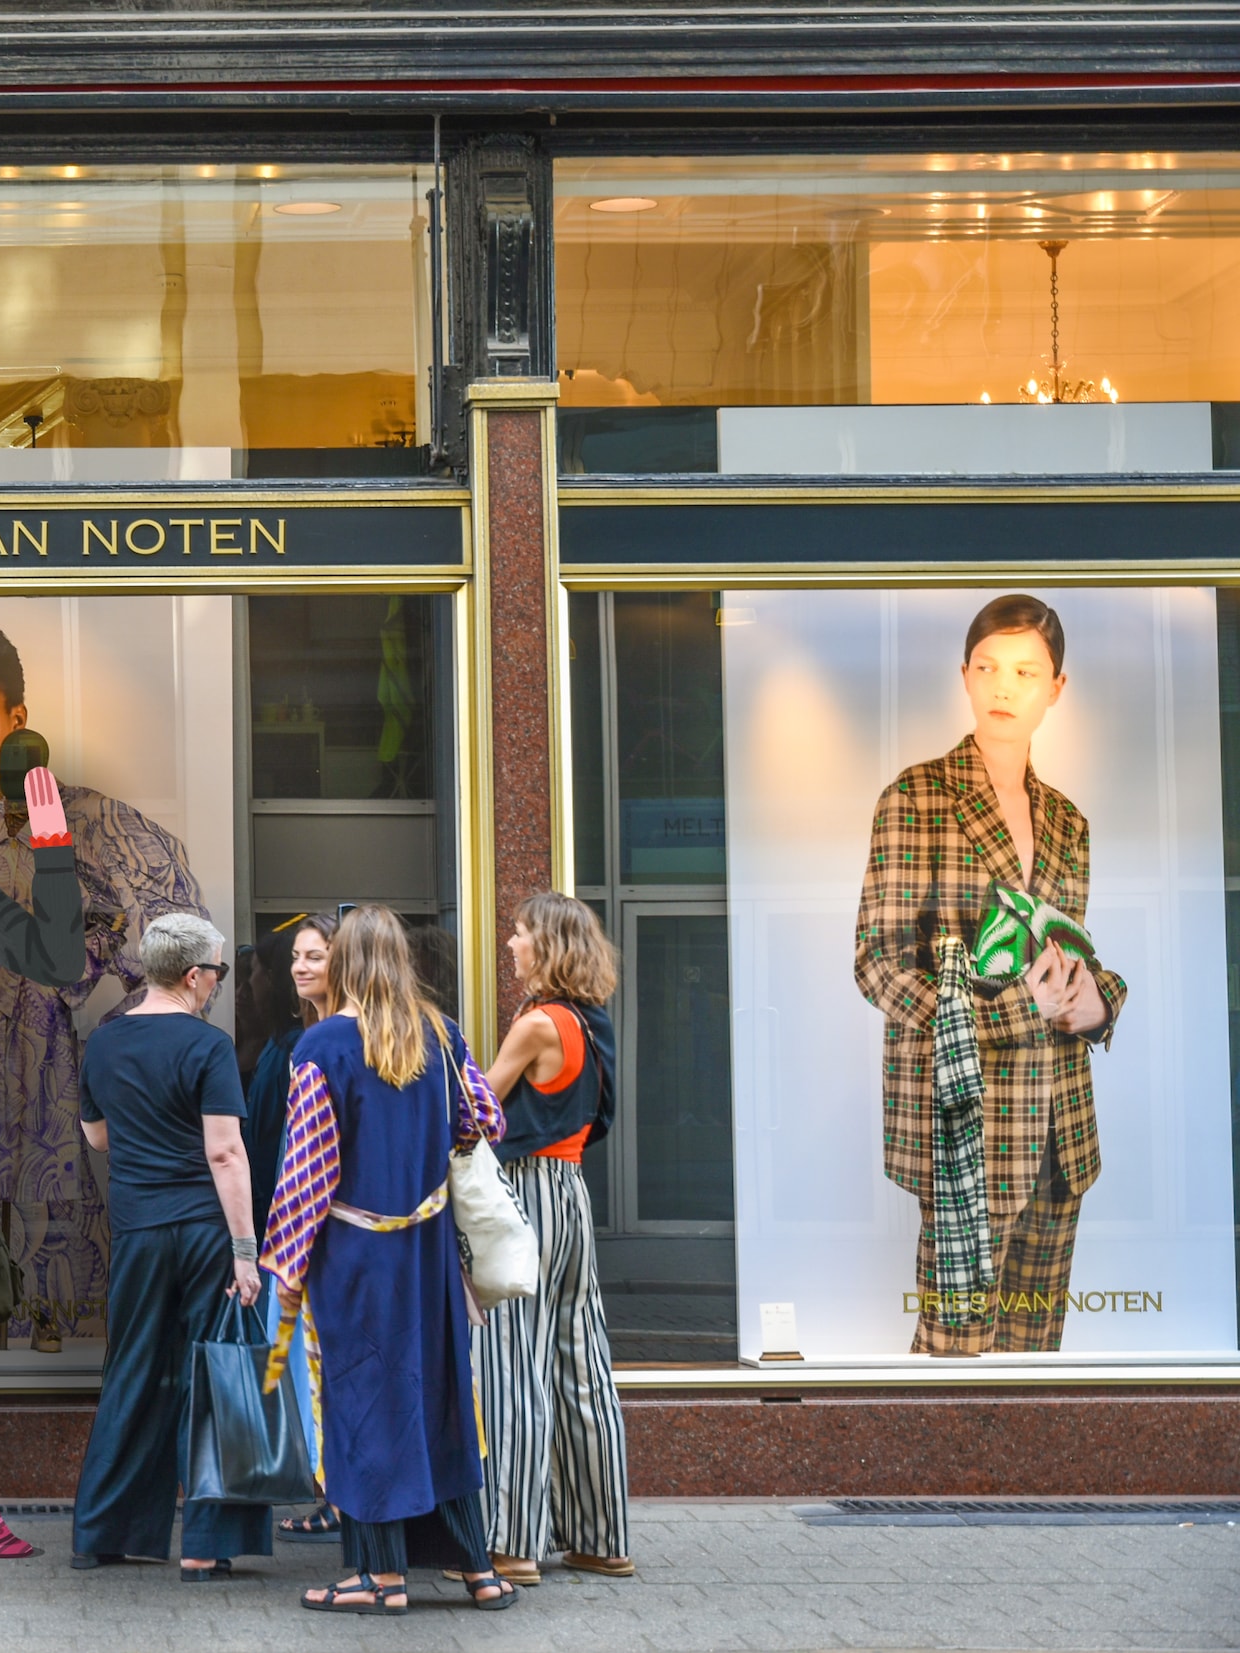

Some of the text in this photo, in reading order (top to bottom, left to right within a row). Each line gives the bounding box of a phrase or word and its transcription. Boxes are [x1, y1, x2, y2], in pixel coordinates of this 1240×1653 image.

[81, 519, 287, 555] NOTEN
[52, 1299, 106, 1320] NOT
[902, 1290, 1164, 1314] DRIES VAN NOTEN
